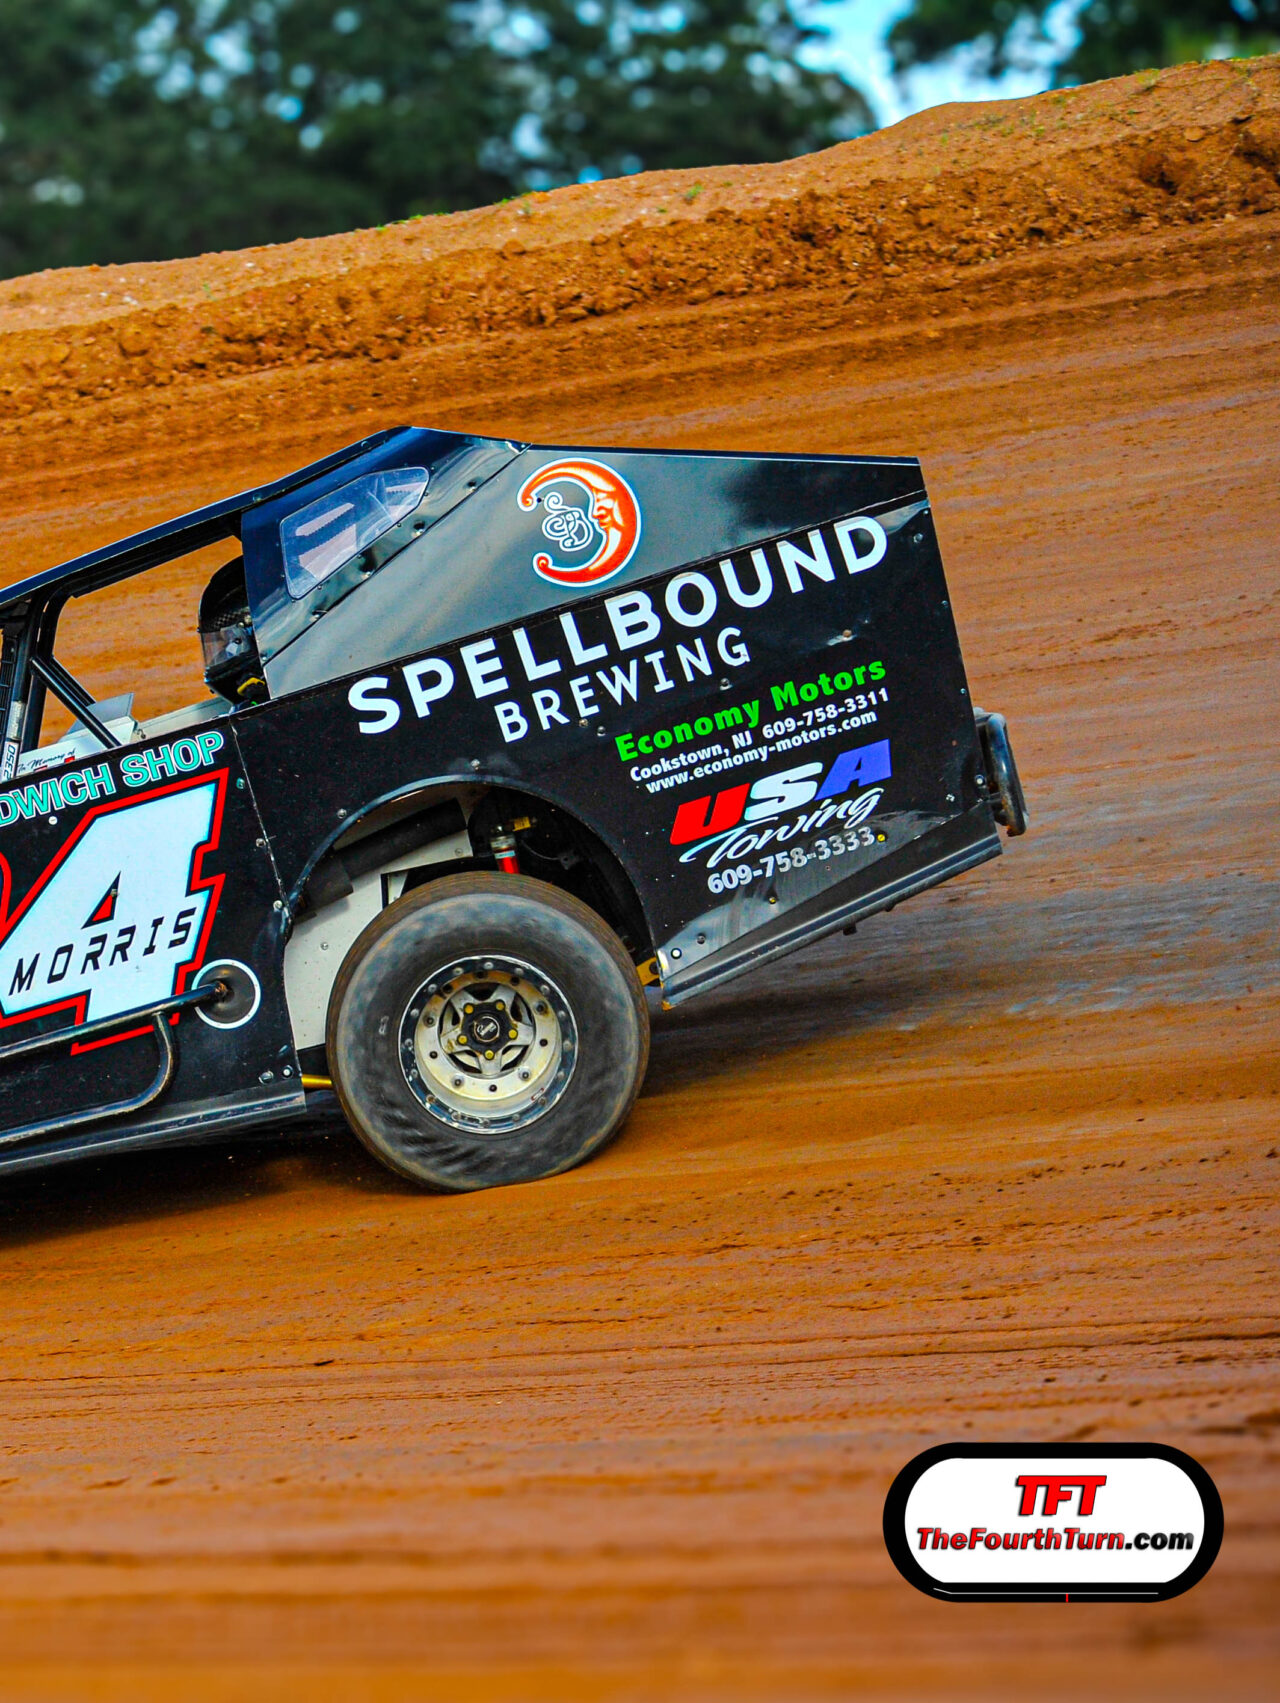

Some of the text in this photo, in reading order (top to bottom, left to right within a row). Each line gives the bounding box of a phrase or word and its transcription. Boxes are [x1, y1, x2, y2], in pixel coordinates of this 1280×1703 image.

[347, 515, 888, 735] SPELLBOUND
[493, 627, 750, 743] BREWING
[614, 660, 887, 762] Economy Motors
[120, 730, 224, 789] SHOP
[630, 687, 889, 782] Cookstown, NJ 609-758-3311
[646, 710, 877, 794] www.economy-motors.com
[670, 738, 892, 845] USA
[678, 787, 885, 869] Towing
[707, 825, 875, 894] 609-758-3333
[7, 906, 197, 997] MORRIS
